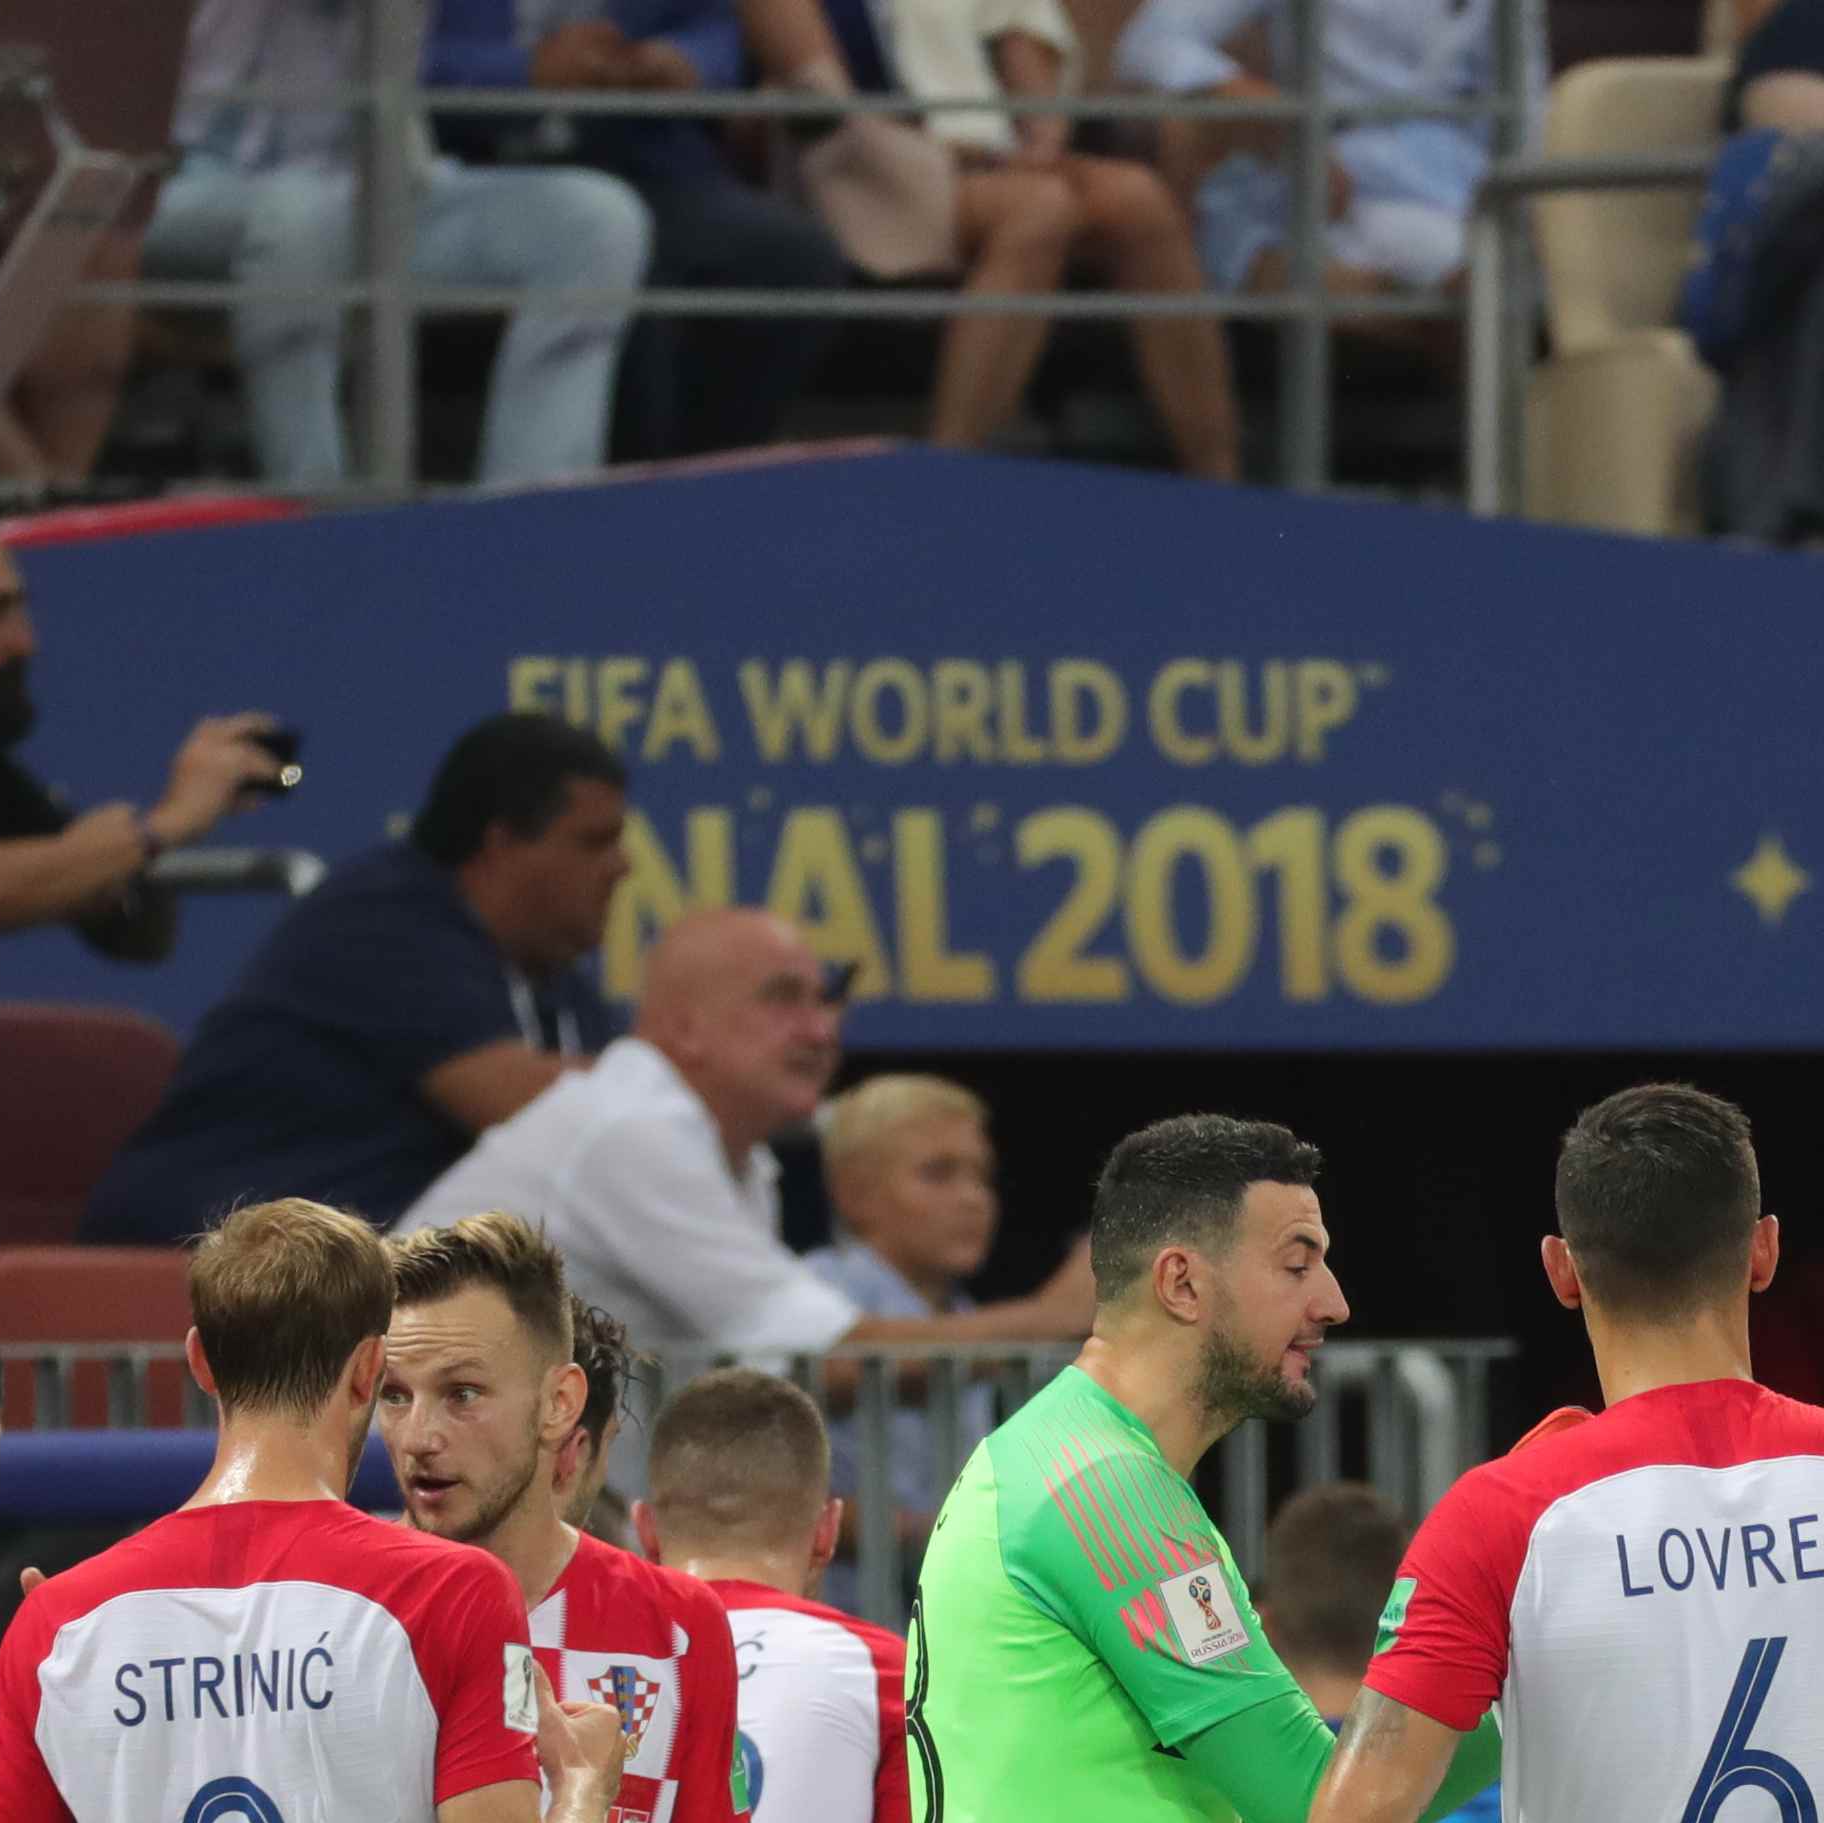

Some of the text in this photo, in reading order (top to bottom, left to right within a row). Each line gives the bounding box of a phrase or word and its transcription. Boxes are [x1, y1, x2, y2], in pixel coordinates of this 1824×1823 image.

[739, 657, 1127, 764] WORLD
[600, 804, 1456, 1005] NAL 2018
[113, 1629, 336, 1727] STRINIĆ
